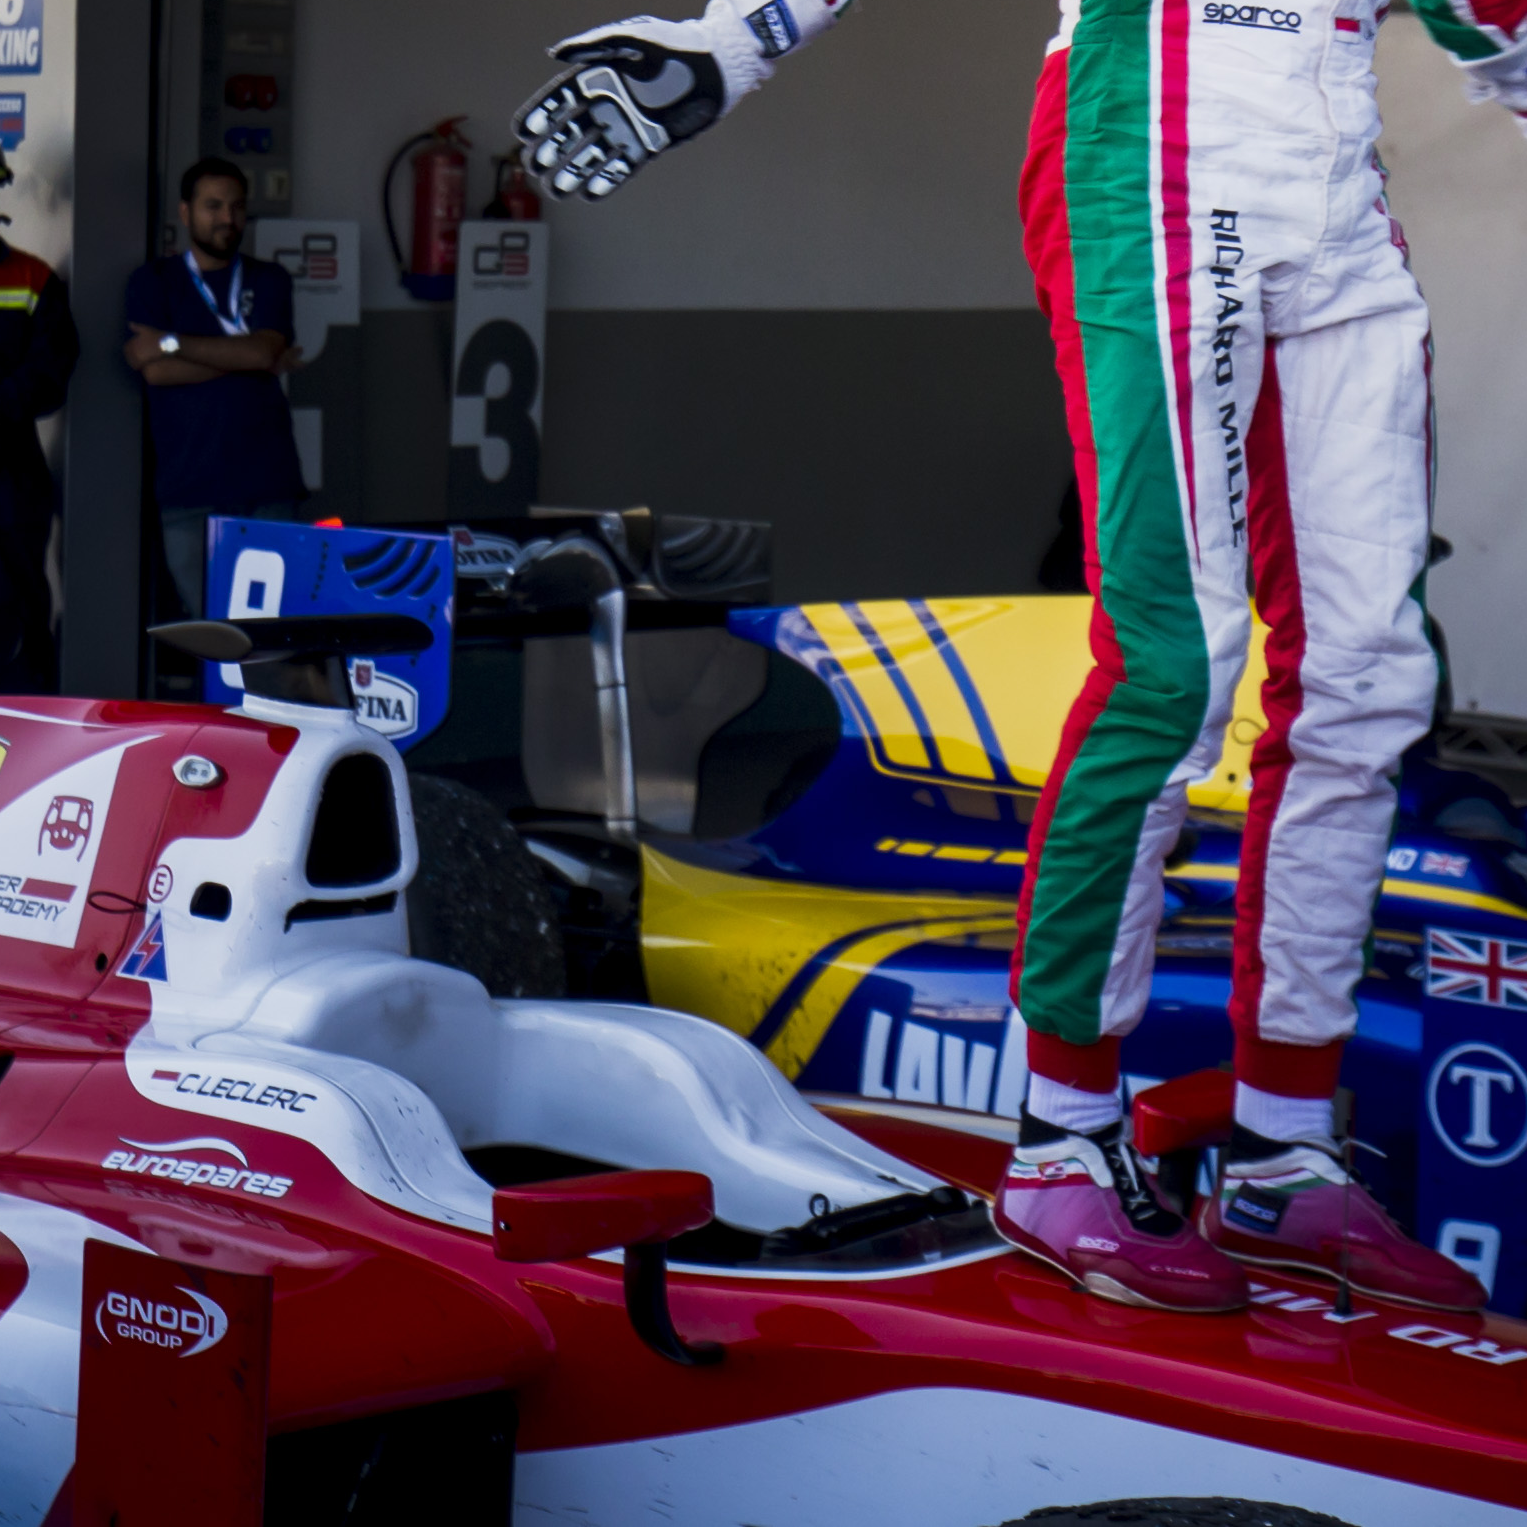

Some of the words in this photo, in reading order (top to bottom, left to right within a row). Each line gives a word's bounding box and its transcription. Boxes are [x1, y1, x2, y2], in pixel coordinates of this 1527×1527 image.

[1202, 2, 1302, 30] sparco
[1210, 207, 1245, 387] RICHARD
[449, 320, 540, 517] 3
[1217, 401, 1247, 549] MILLE
[101, 1149, 295, 1199] eurospares
[116, 1320, 183, 1350] GROUP
